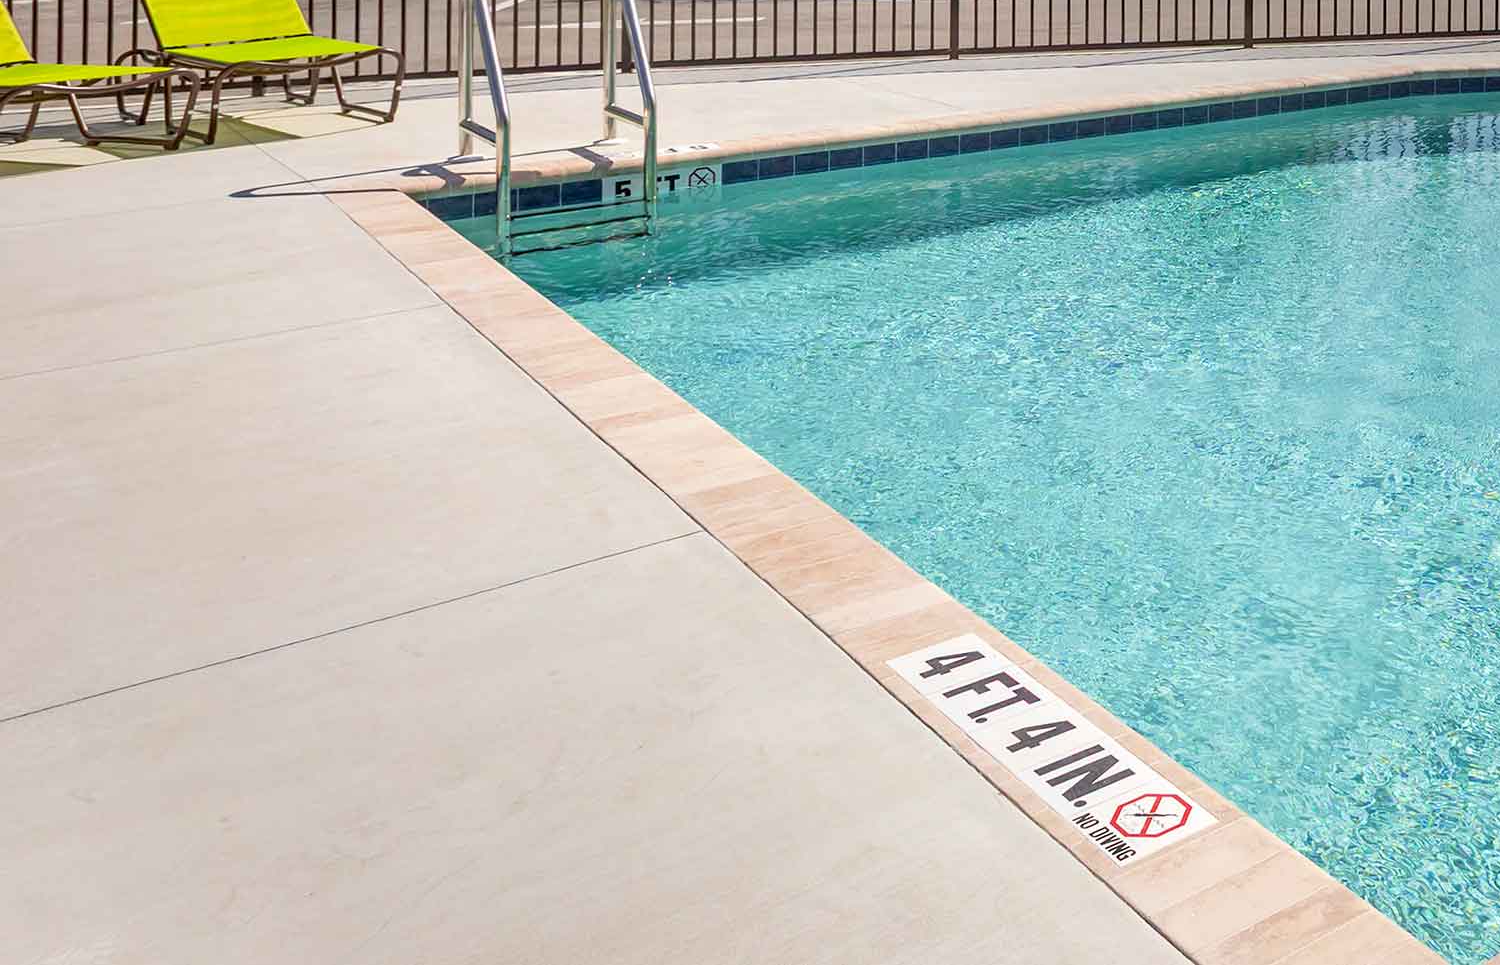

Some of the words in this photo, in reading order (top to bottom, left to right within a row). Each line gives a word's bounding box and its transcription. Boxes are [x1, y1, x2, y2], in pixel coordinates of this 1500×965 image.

[615, 180, 631, 197] 5
[919, 651, 985, 679] 4
[942, 671, 1041, 724] FT.
[1005, 720, 1076, 753] 4
[1033, 744, 1136, 808] IN.
[1072, 812, 1100, 830] NO
[1088, 826, 1137, 862] DIVING
